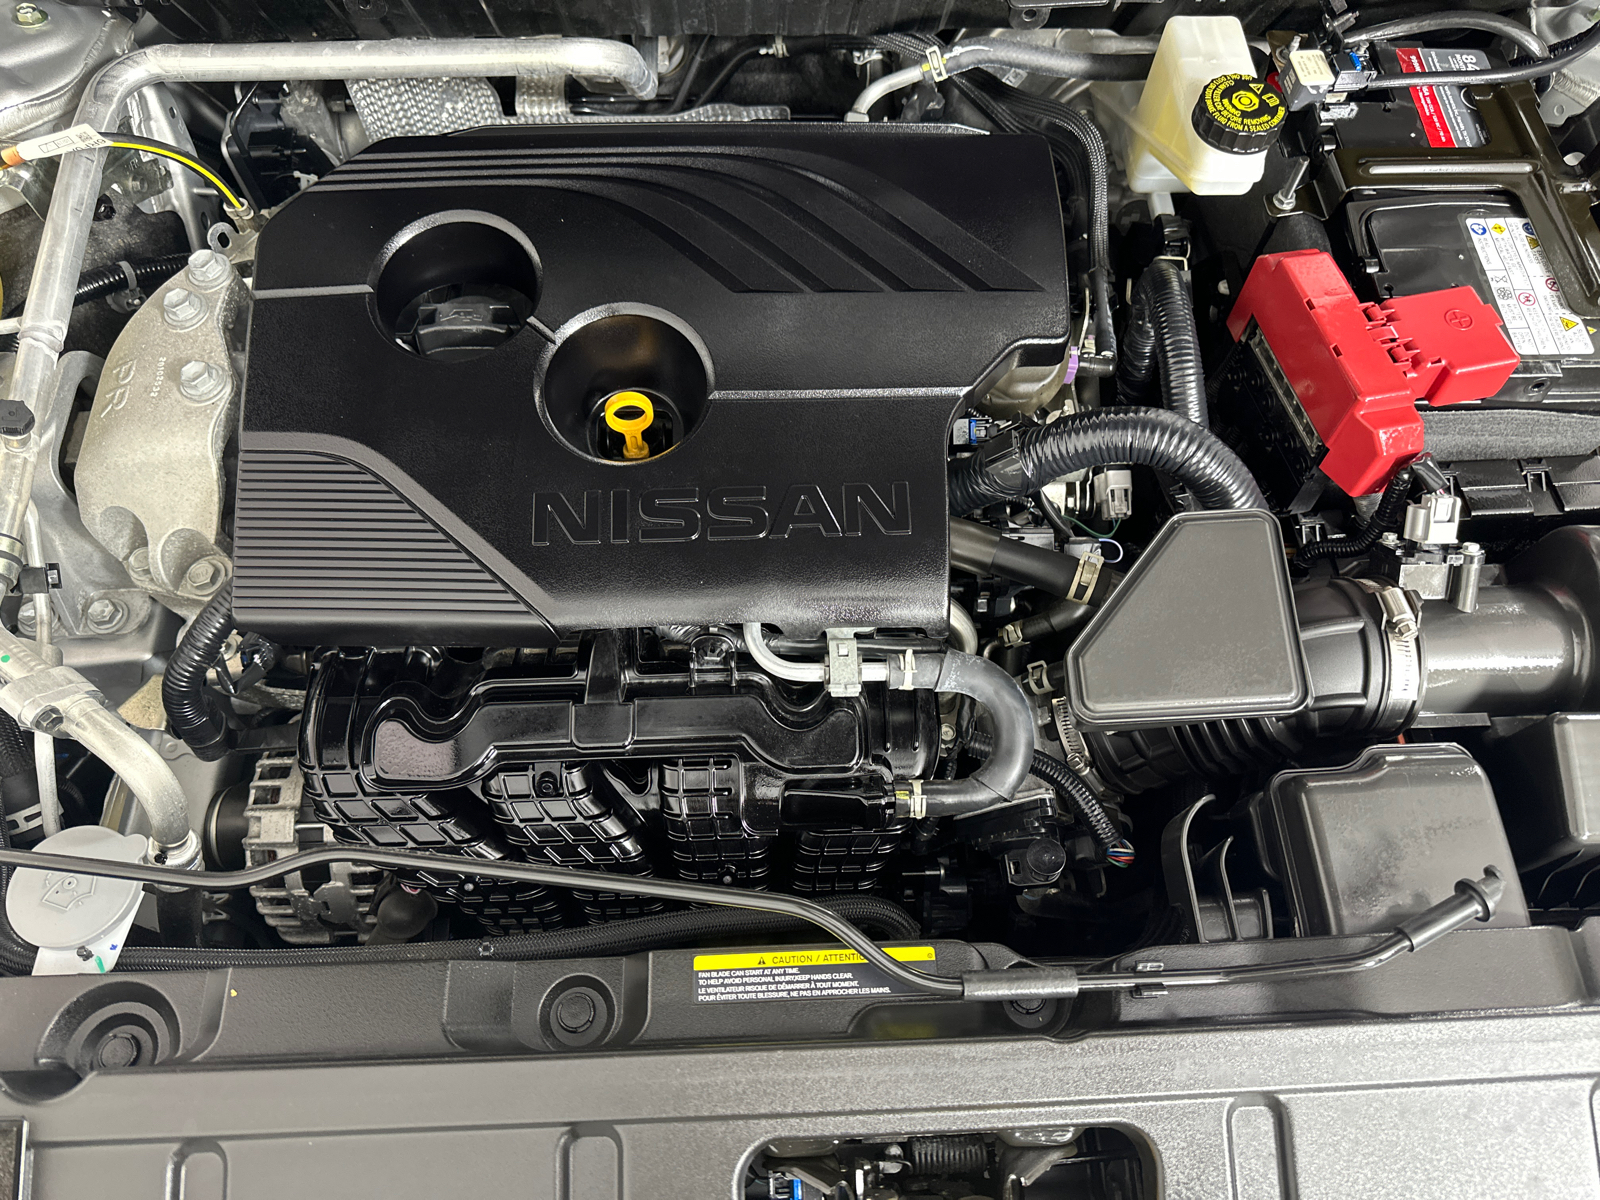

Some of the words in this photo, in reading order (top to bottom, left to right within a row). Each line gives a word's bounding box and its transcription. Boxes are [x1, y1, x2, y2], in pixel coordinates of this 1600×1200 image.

[1462, 55, 1480, 70] 84
[1214, 101, 1224, 110] CAP
[1221, 109, 1242, 124] BEFORE
[1244, 114, 1270, 125] REMOVING
[1222, 98, 1241, 118] WARNING
[1213, 112, 1227, 124] FLUID
[1227, 120, 1243, 130] FROM
[1249, 123, 1270, 132] SEALED
[532, 480, 913, 547] NISSAN
[772, 955, 812, 964] CAUTION
[823, 952, 866, 962] ATTENTIO
